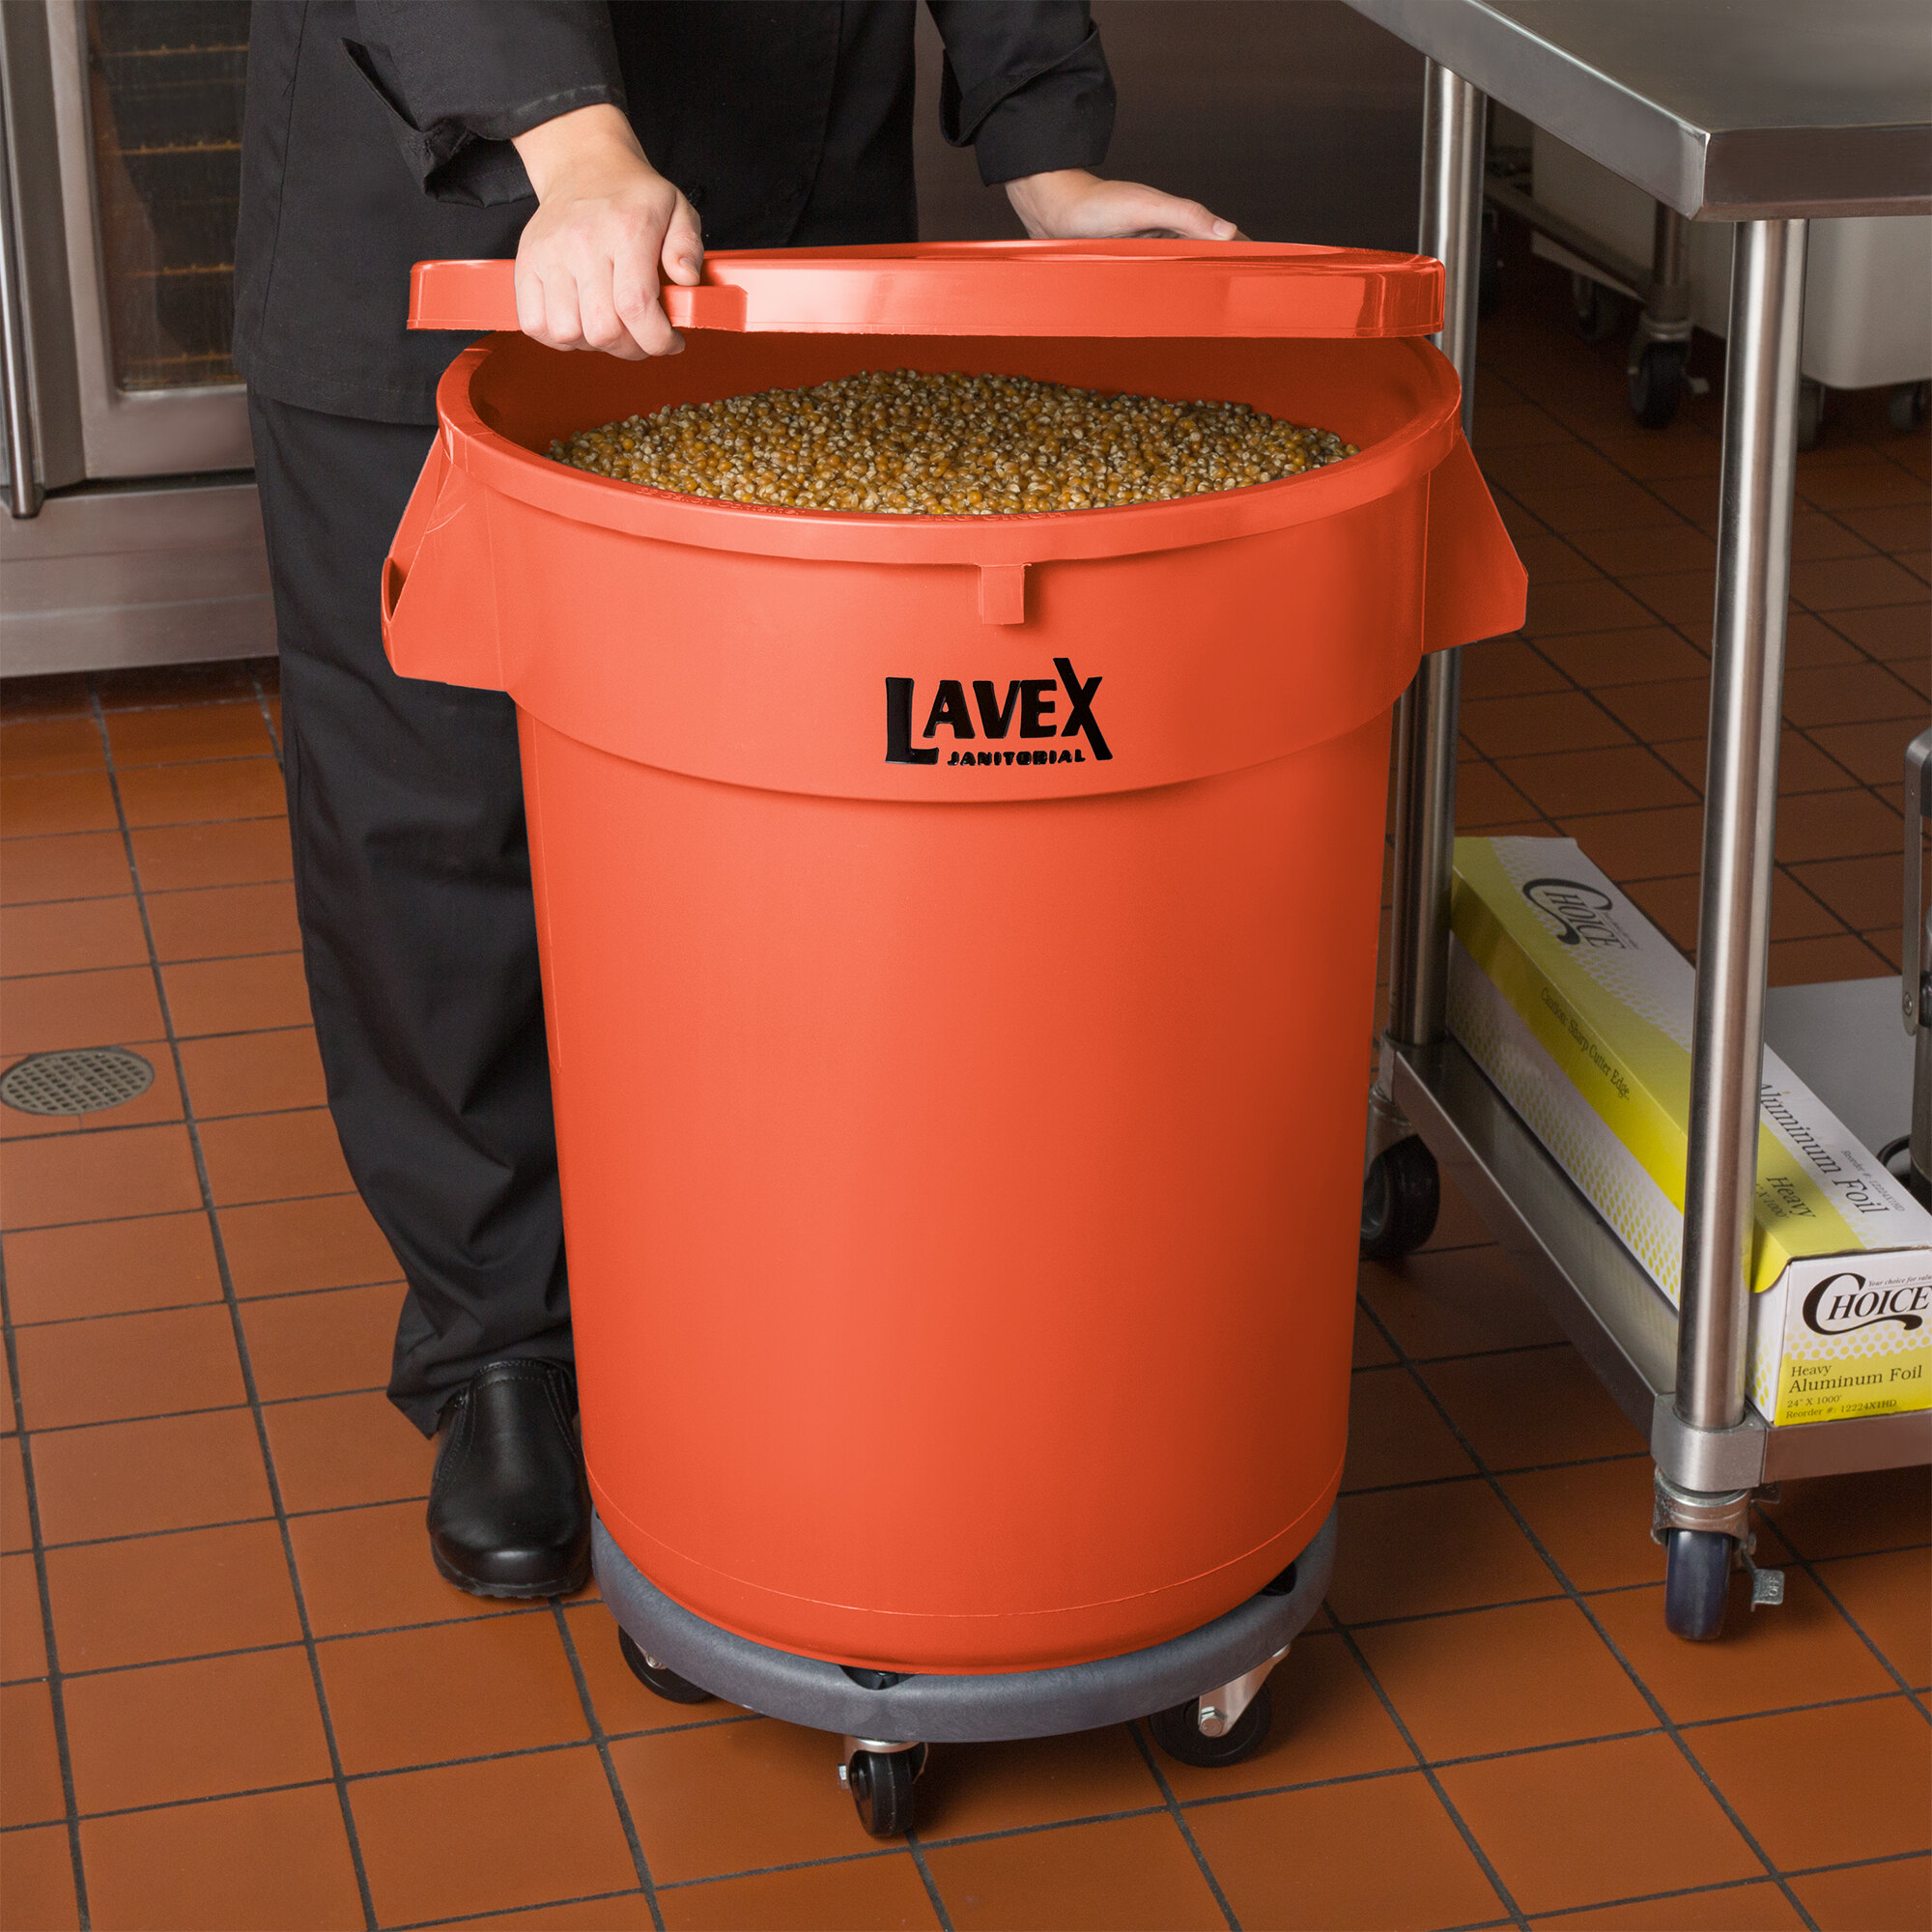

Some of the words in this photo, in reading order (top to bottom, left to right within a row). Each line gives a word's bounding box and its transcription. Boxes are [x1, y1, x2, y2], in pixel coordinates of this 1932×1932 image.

[885, 658, 1113, 765] LAVEX
[948, 750, 1086, 766] JANITORIAL
[1522, 878, 1626, 949] CHOICE
[1568, 1019, 1590, 1052] Sharp
[1588, 1044, 1611, 1076] Cutter
[1766, 1177, 1816, 1218] Heavy
[1832, 1179, 1890, 1214] Foil
[1803, 1272, 1932, 1335] CHOICE
[1789, 1373, 1883, 1393] Aluminum
[1889, 1365, 1922, 1382] Foil
[1791, 1365, 1832, 1378] Heavy
[1786, 1408, 1823, 1419] Reorder
